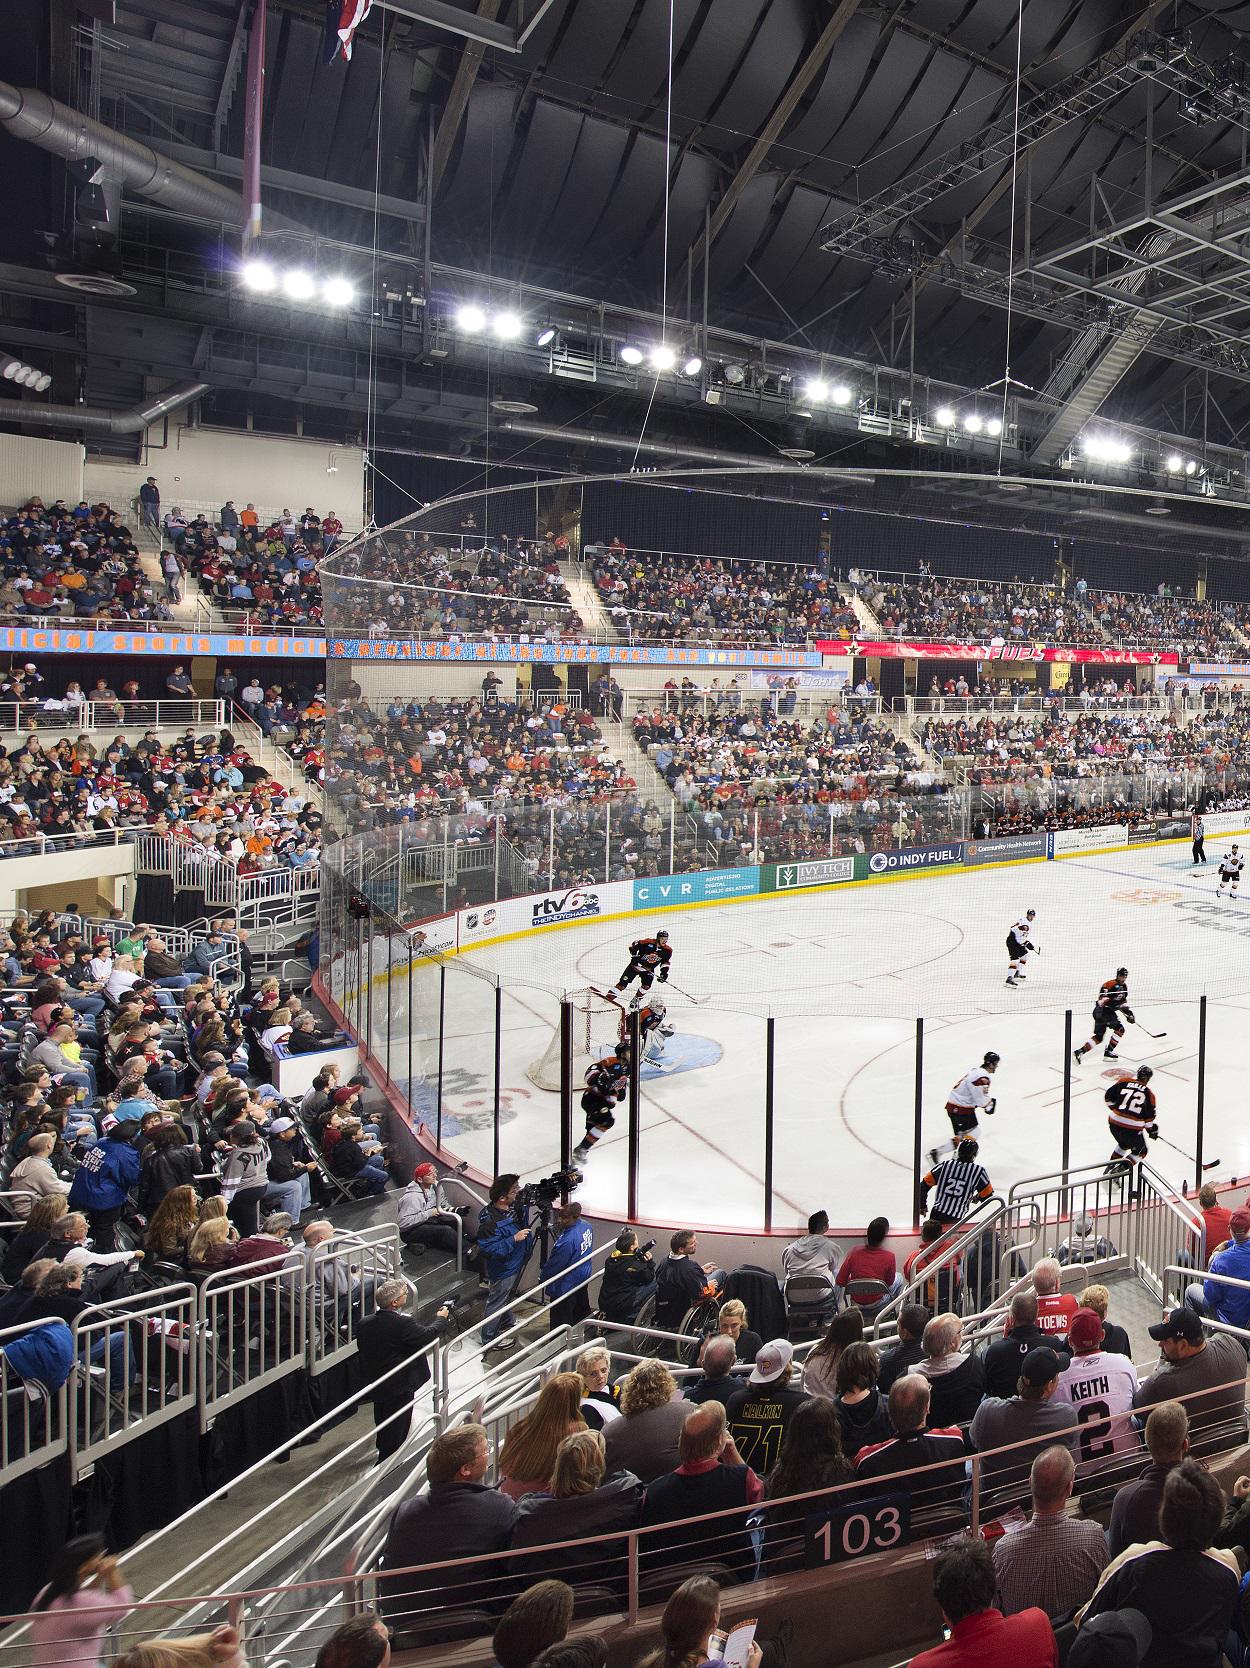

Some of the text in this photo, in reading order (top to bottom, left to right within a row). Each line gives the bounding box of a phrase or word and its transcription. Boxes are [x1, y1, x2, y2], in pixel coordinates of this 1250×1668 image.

[113, 634, 211, 655] sports
[977, 843, 1006, 853] Community
[1006, 842, 1022, 850] Health
[1022, 839, 1042, 848] Network
[899, 852, 927, 866] INDY
[928, 849, 955, 862] FUEL
[800, 862, 851, 877] IVY TECH
[724, 884, 754, 893] RELATIONS
[584, 896, 599, 906] abc
[1118, 1088, 1146, 1114] 72
[944, 1178, 966, 1196] 25
[1037, 1314, 1068, 1330] TOEWS
[1070, 1375, 1110, 1401] KEITH
[742, 1403, 783, 1419] MALKIN
[1077, 1401, 1115, 1462] 2
[731, 1423, 784, 1474] 71
[814, 1506, 902, 1561] 103
